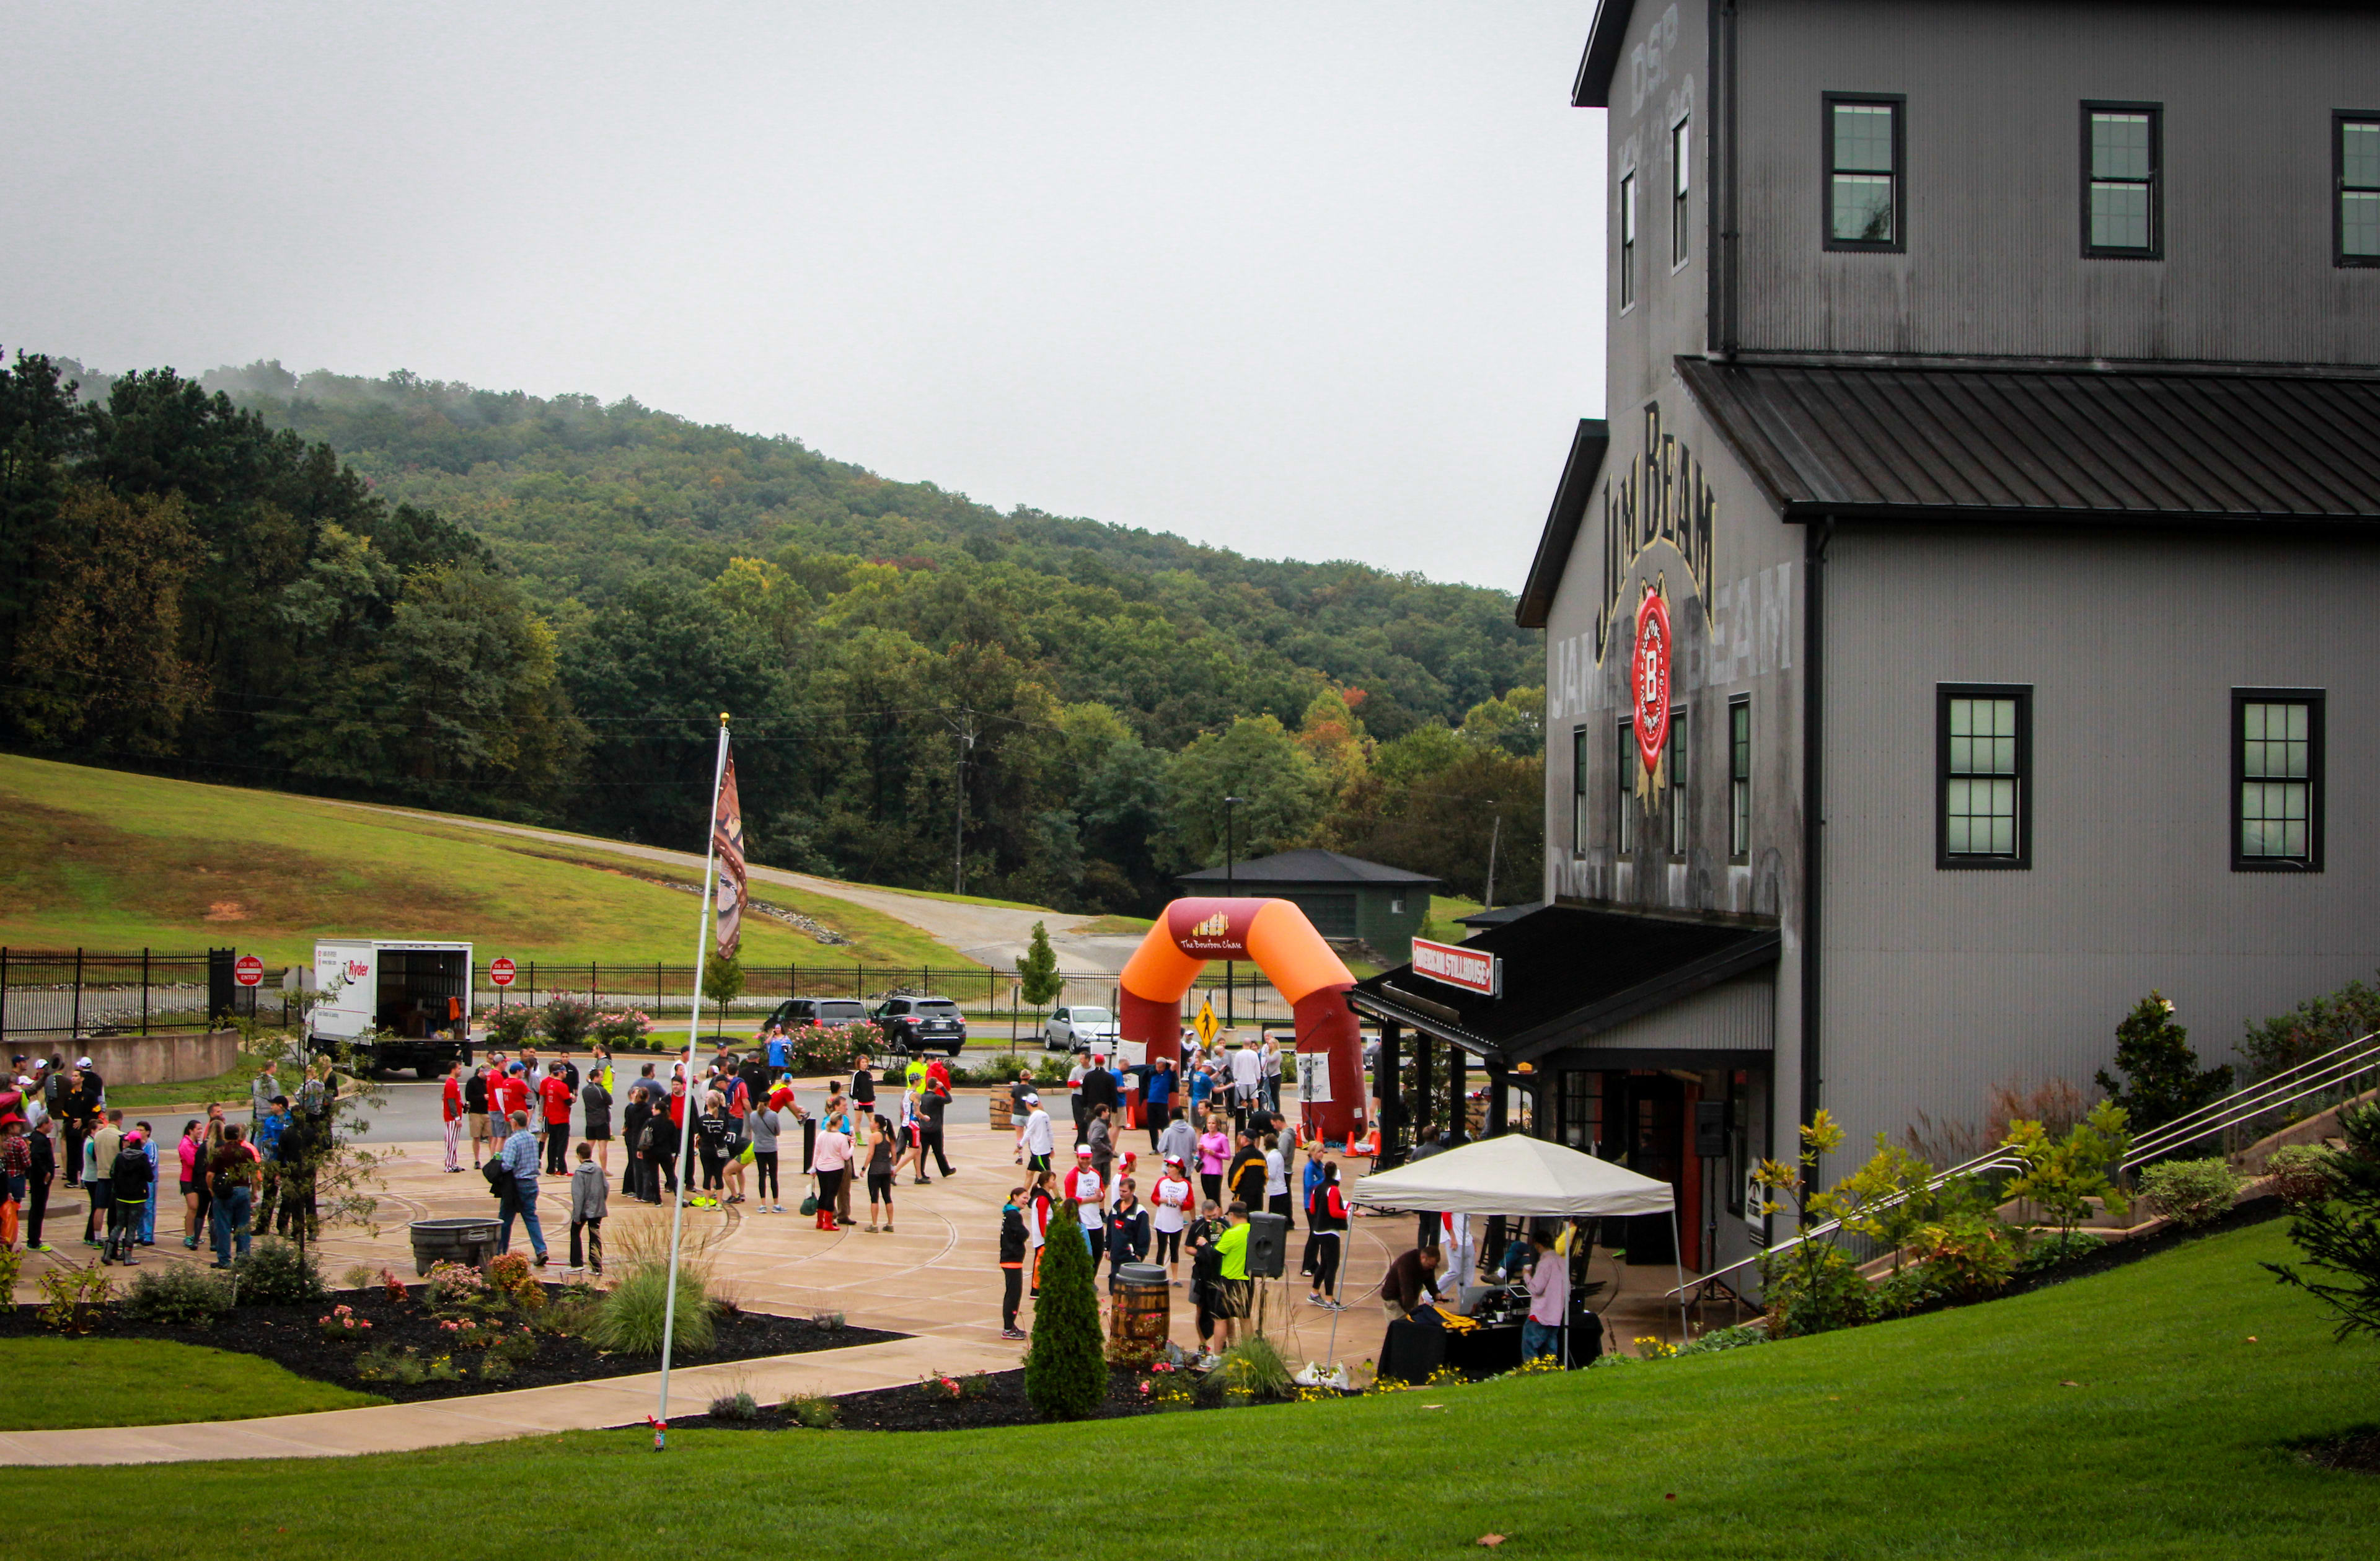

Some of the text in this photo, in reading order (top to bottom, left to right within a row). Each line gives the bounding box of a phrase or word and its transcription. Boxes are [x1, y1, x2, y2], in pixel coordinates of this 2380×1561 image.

[1631, 2, 1678, 118] DSP
[1596, 400, 1717, 671] JIM BEAM
[1646, 651, 1657, 701] B
[1181, 939, 1242, 949] The Bourbon Chase
[1416, 946, 1487, 985] AMERICAN STILLHOUSE
[349, 960, 369, 980] Ryder
